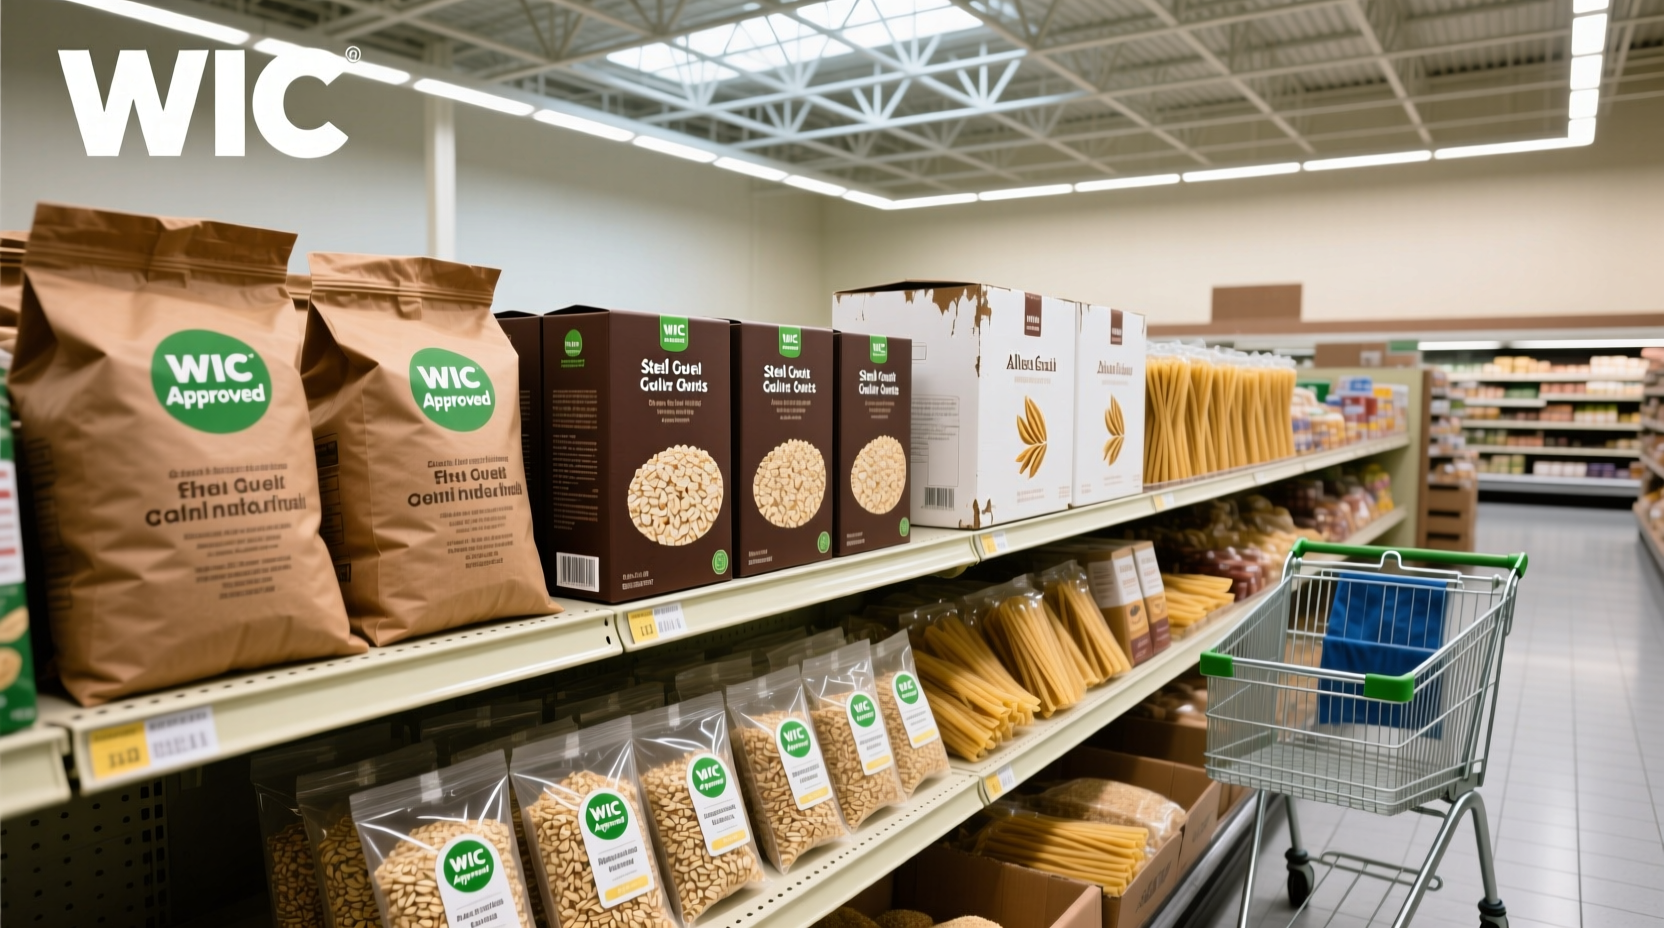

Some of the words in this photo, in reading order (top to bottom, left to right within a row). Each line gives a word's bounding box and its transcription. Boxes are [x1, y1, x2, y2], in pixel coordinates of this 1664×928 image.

[663, 324, 685, 336] WIC
[416, 366, 481, 389] WIC
[166, 383, 266, 409] Approved
[423, 390, 492, 412] Approved
[589, 801, 622, 822] WIC
[449, 848, 486, 873] WIC
